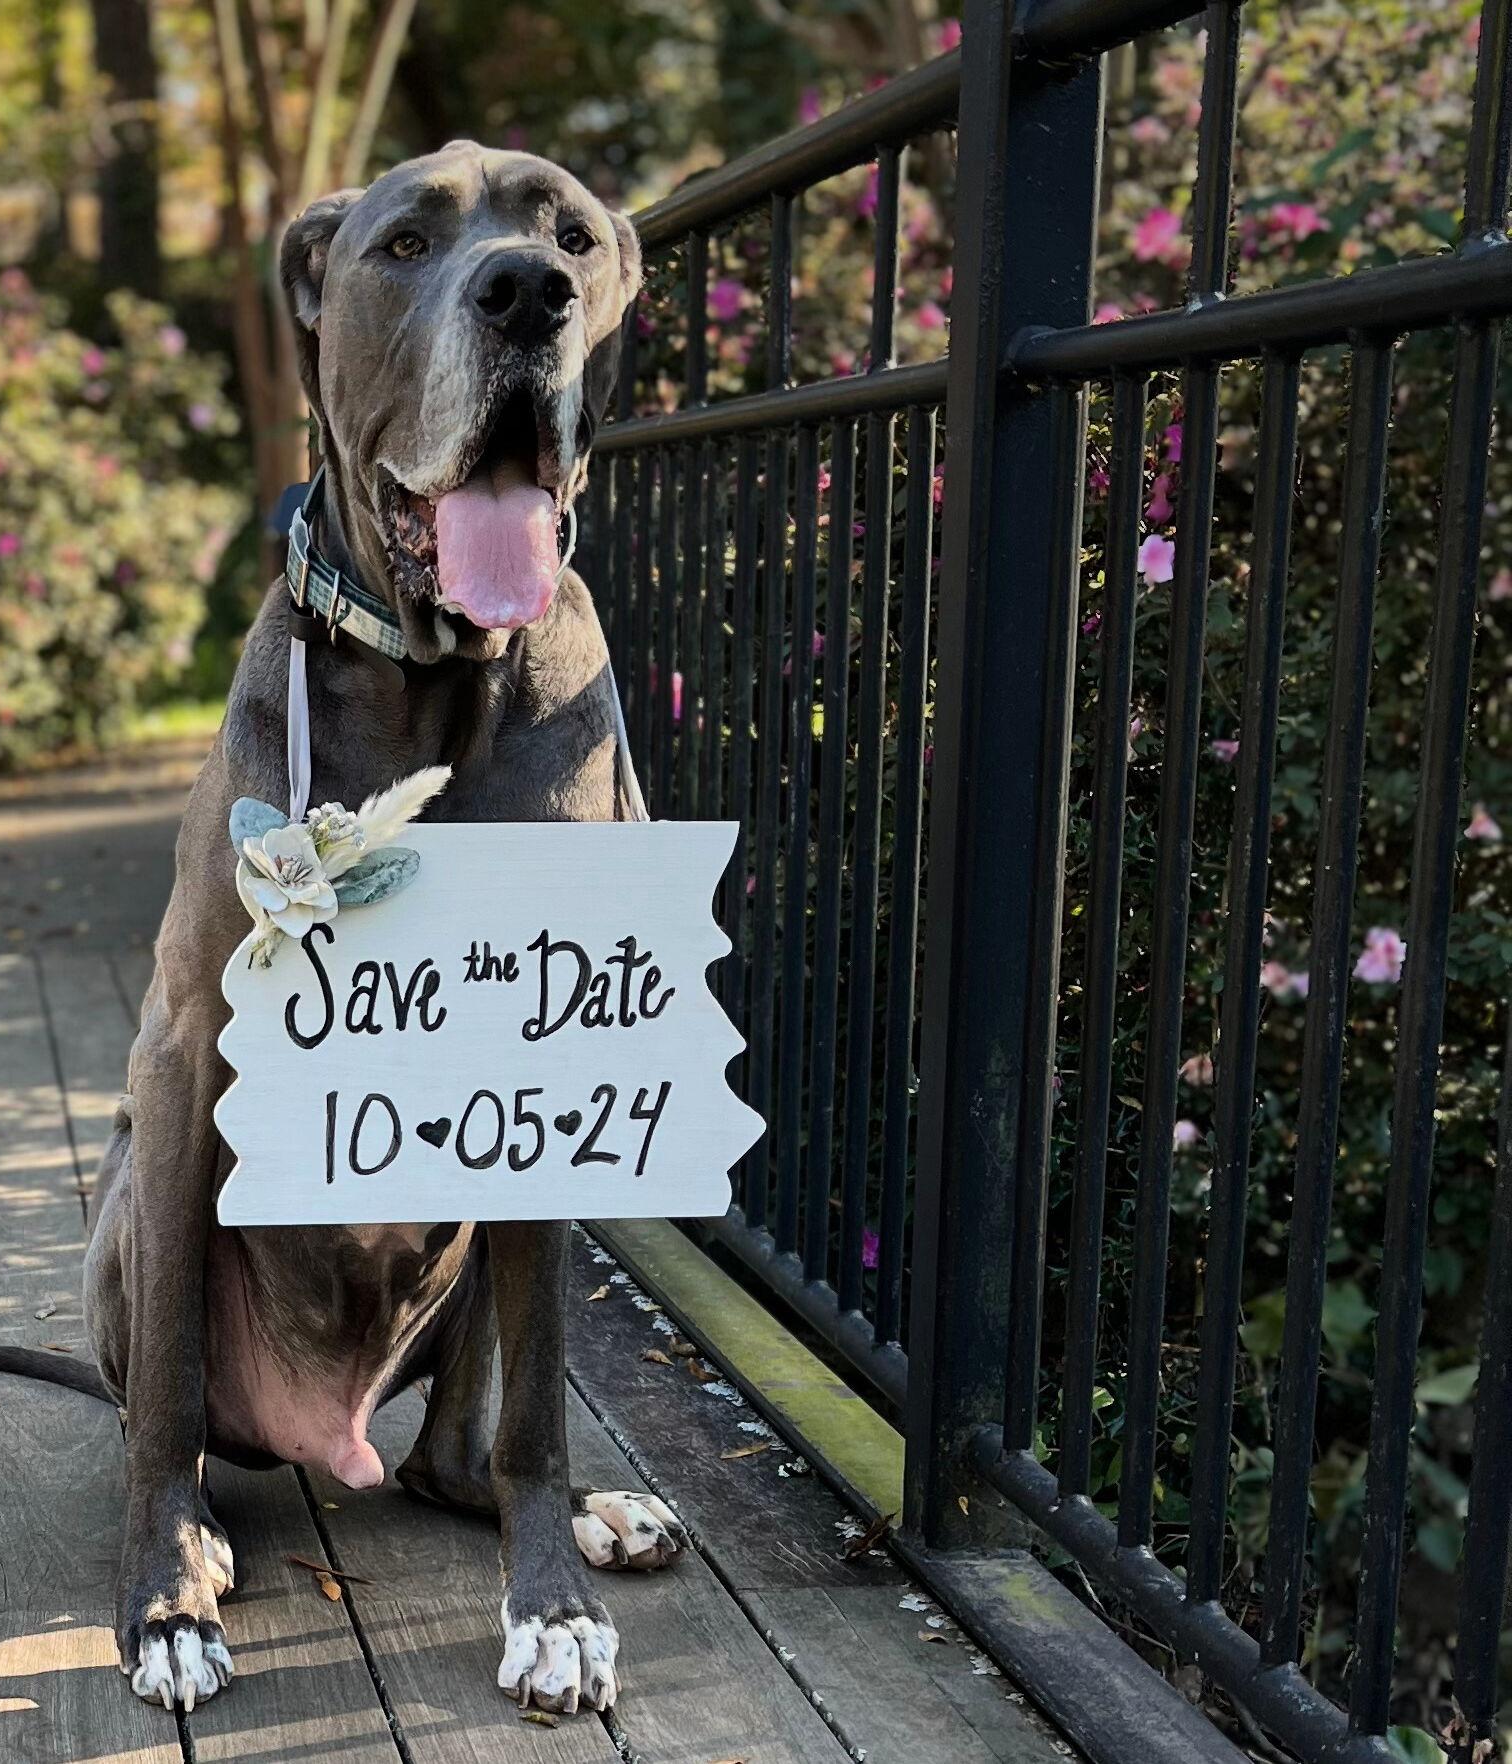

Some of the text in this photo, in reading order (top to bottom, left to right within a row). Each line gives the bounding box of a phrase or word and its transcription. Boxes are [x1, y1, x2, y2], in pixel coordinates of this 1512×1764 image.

[284, 923, 675, 1050] Save the Date
